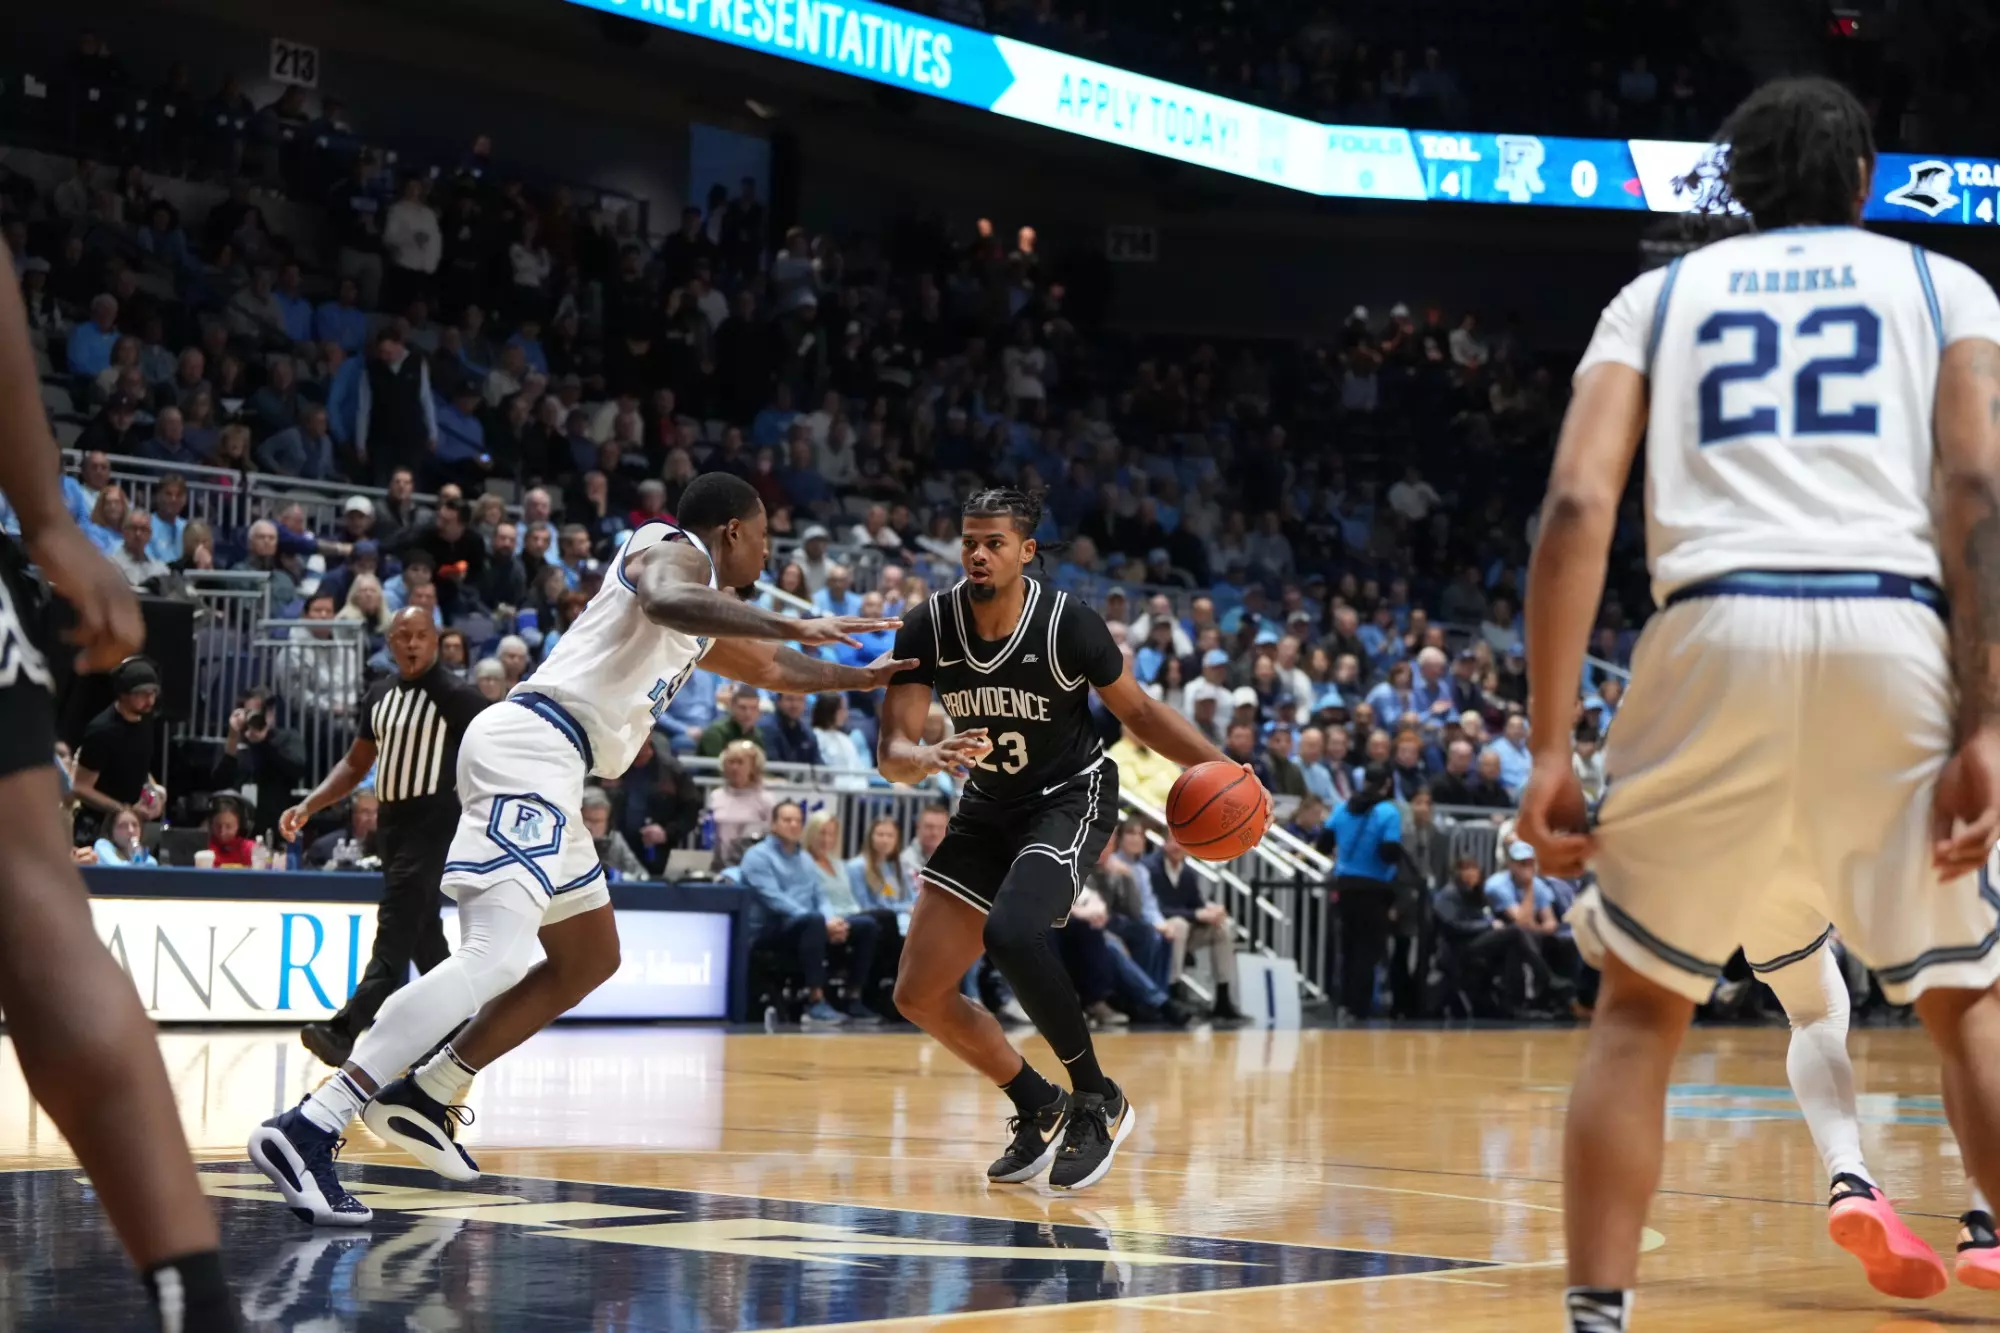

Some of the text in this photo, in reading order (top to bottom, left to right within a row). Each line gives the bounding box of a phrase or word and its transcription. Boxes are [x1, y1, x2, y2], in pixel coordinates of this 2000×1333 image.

[275, 44, 315, 83] 213
[639, 0, 952, 89] RESENTATIVES
[1056, 71, 1240, 159] APPLY TODAY!
[1440, 171, 1461, 197] 4
[1571, 160, 1598, 198] 0
[1975, 197, 1994, 223] 4
[1696, 301, 1882, 447] 22
[942, 686, 1051, 722] PROVIDENCE
